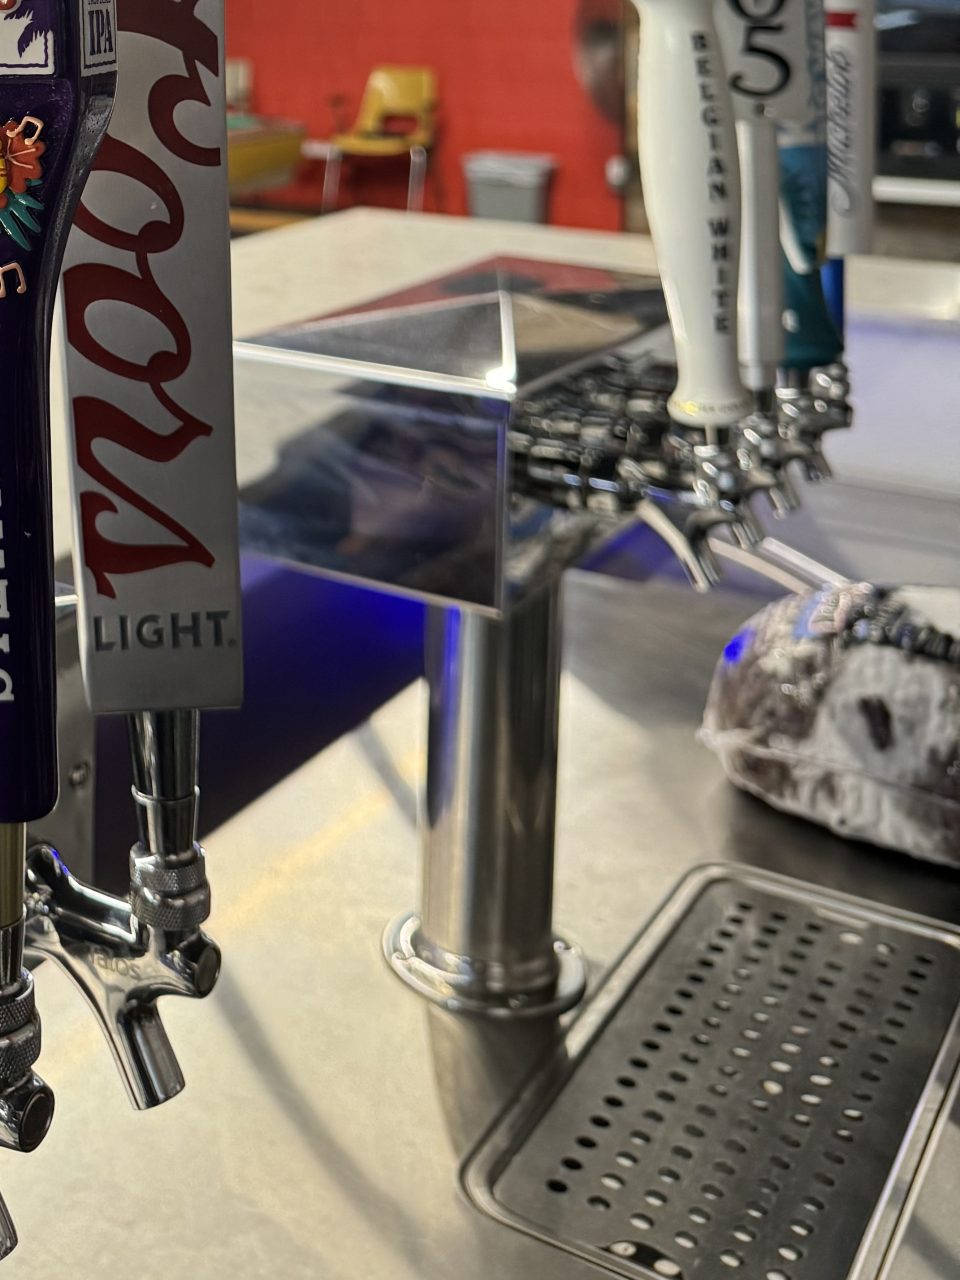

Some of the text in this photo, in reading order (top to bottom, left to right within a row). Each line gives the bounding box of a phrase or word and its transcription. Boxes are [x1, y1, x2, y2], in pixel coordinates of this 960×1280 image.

[88, 9, 114, 55] IPA
[691, 34, 729, 333] BELGIAN WHITE
